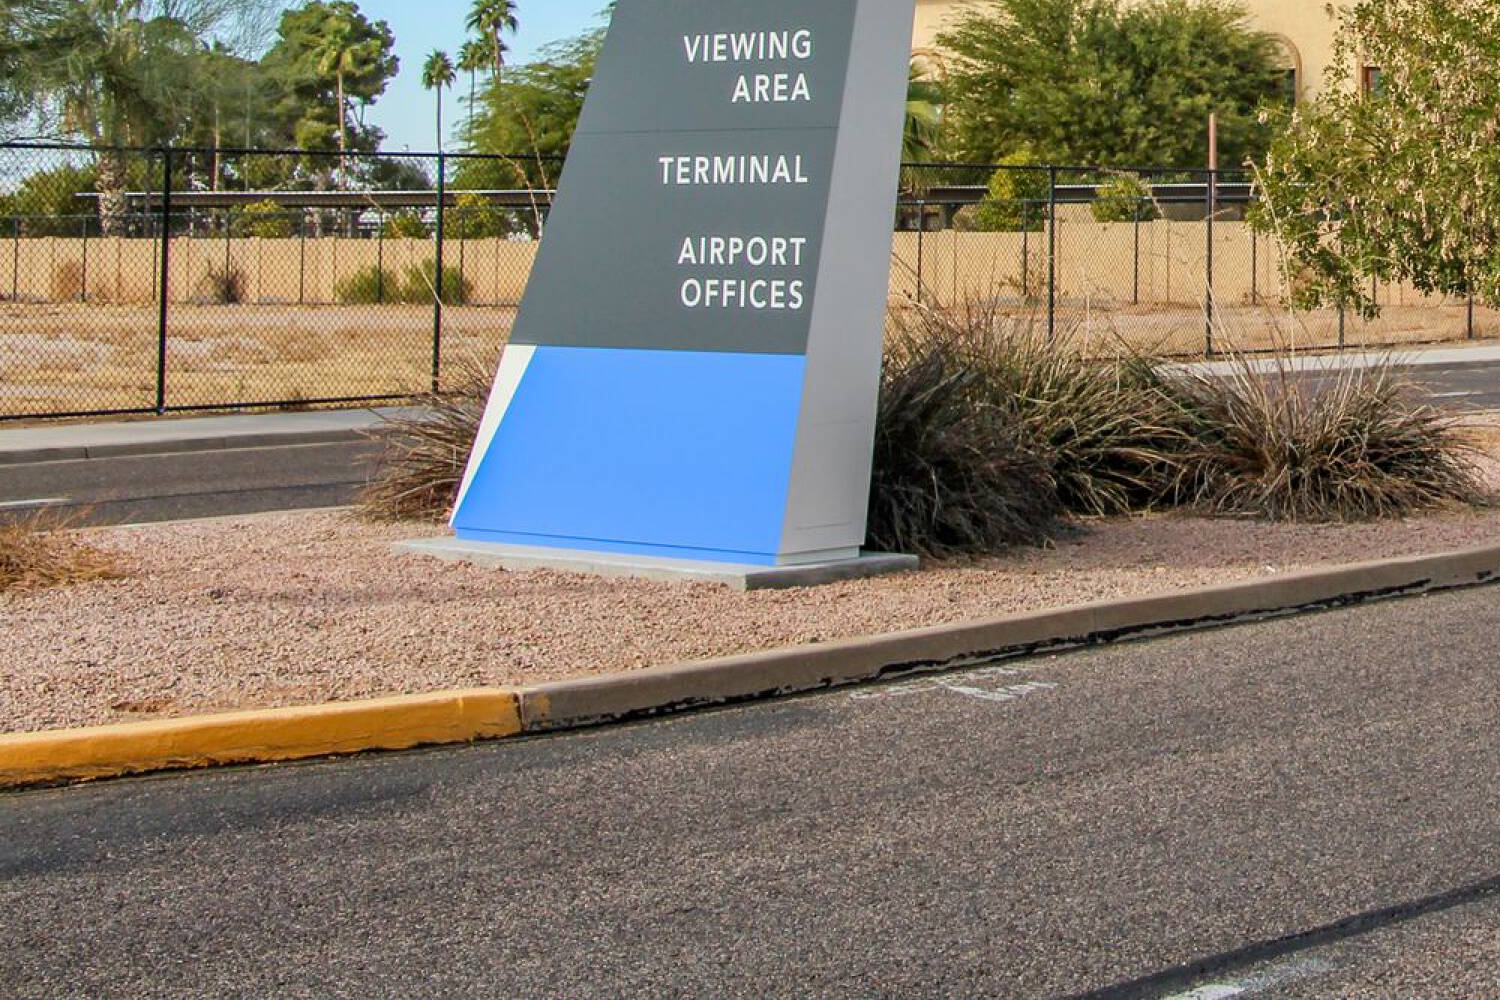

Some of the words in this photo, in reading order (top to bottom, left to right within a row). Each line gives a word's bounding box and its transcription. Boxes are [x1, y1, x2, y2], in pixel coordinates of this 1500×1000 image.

[684, 30, 811, 62] VIEWING
[732, 73, 810, 103] AREA
[659, 155, 808, 184] TERMINAL
[678, 237, 806, 265] AIRPORT
[681, 278, 803, 309] OFFICES
